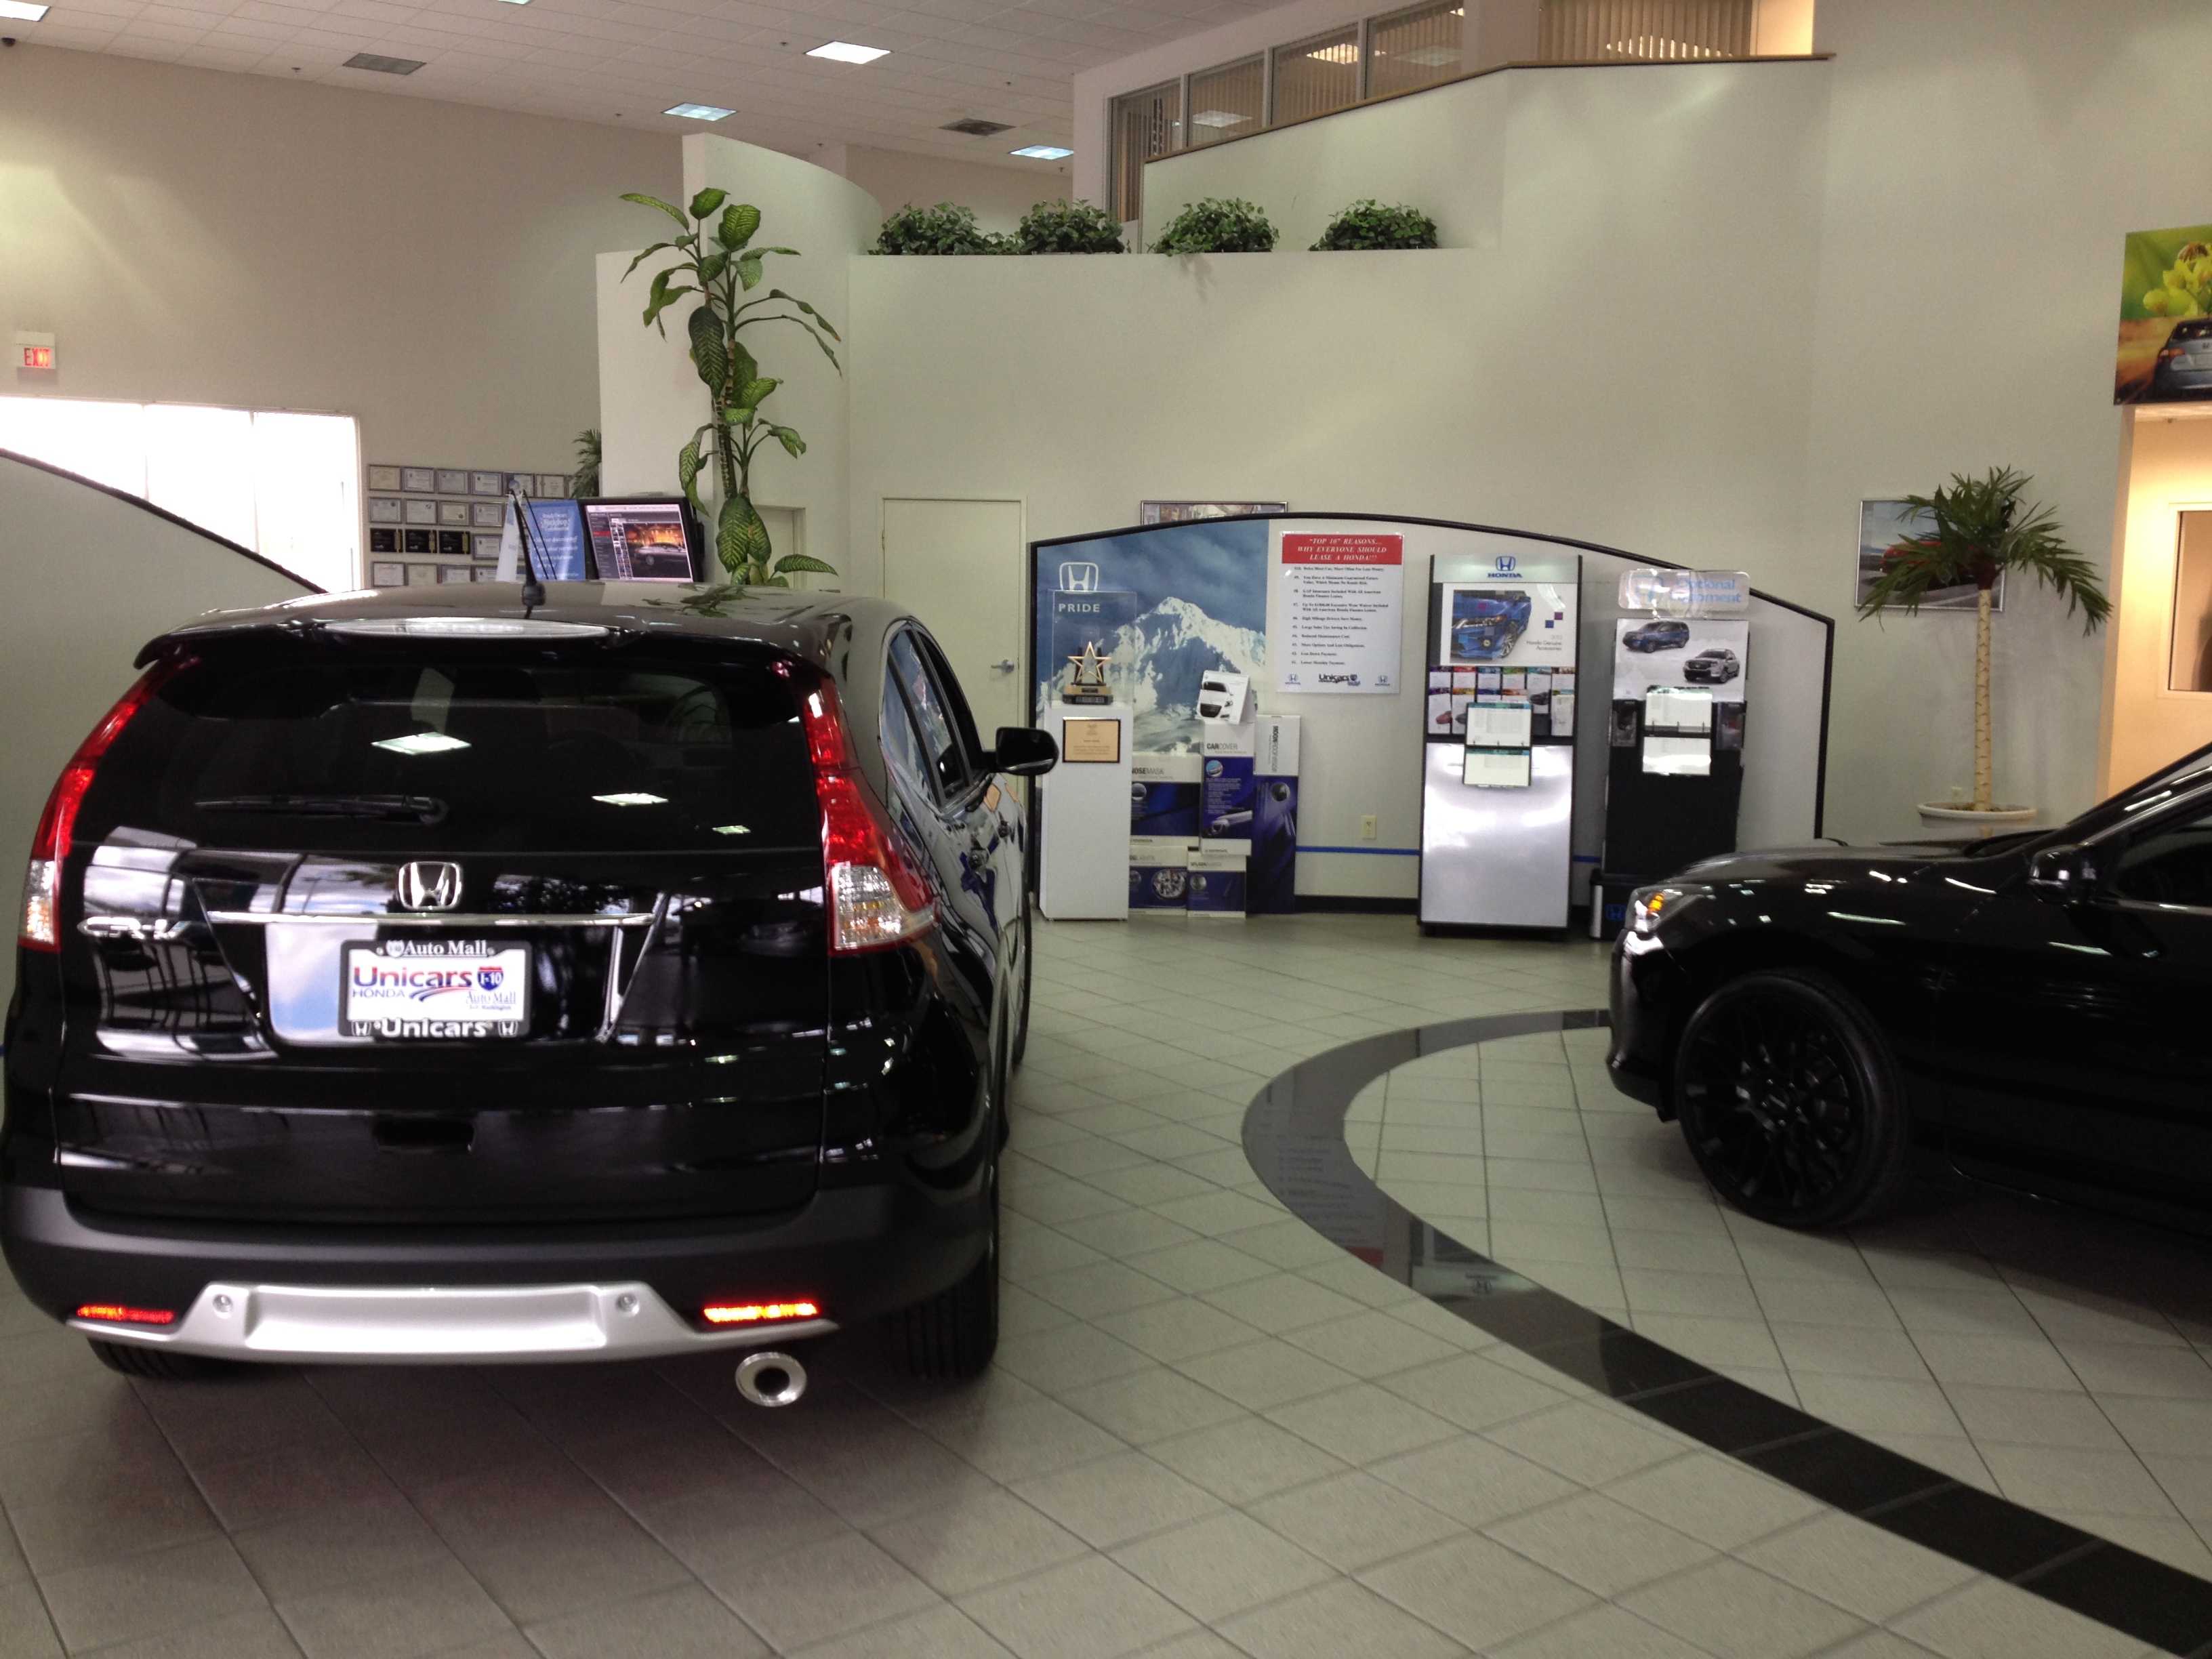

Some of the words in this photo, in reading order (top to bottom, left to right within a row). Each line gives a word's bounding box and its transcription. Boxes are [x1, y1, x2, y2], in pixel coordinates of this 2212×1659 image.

[1059, 603, 1100, 613] PRIDE
[77, 916, 191, 940] CR-V
[403, 940, 444, 956] Auto
[447, 939, 487, 956] Mall
[354, 966, 472, 987] Unicars
[480, 972, 502, 984] I-10
[352, 989, 405, 998] HONDA
[466, 991, 491, 1004] Auto
[493, 991, 516, 1004] Mall
[381, 1017, 487, 1038] Unicars
